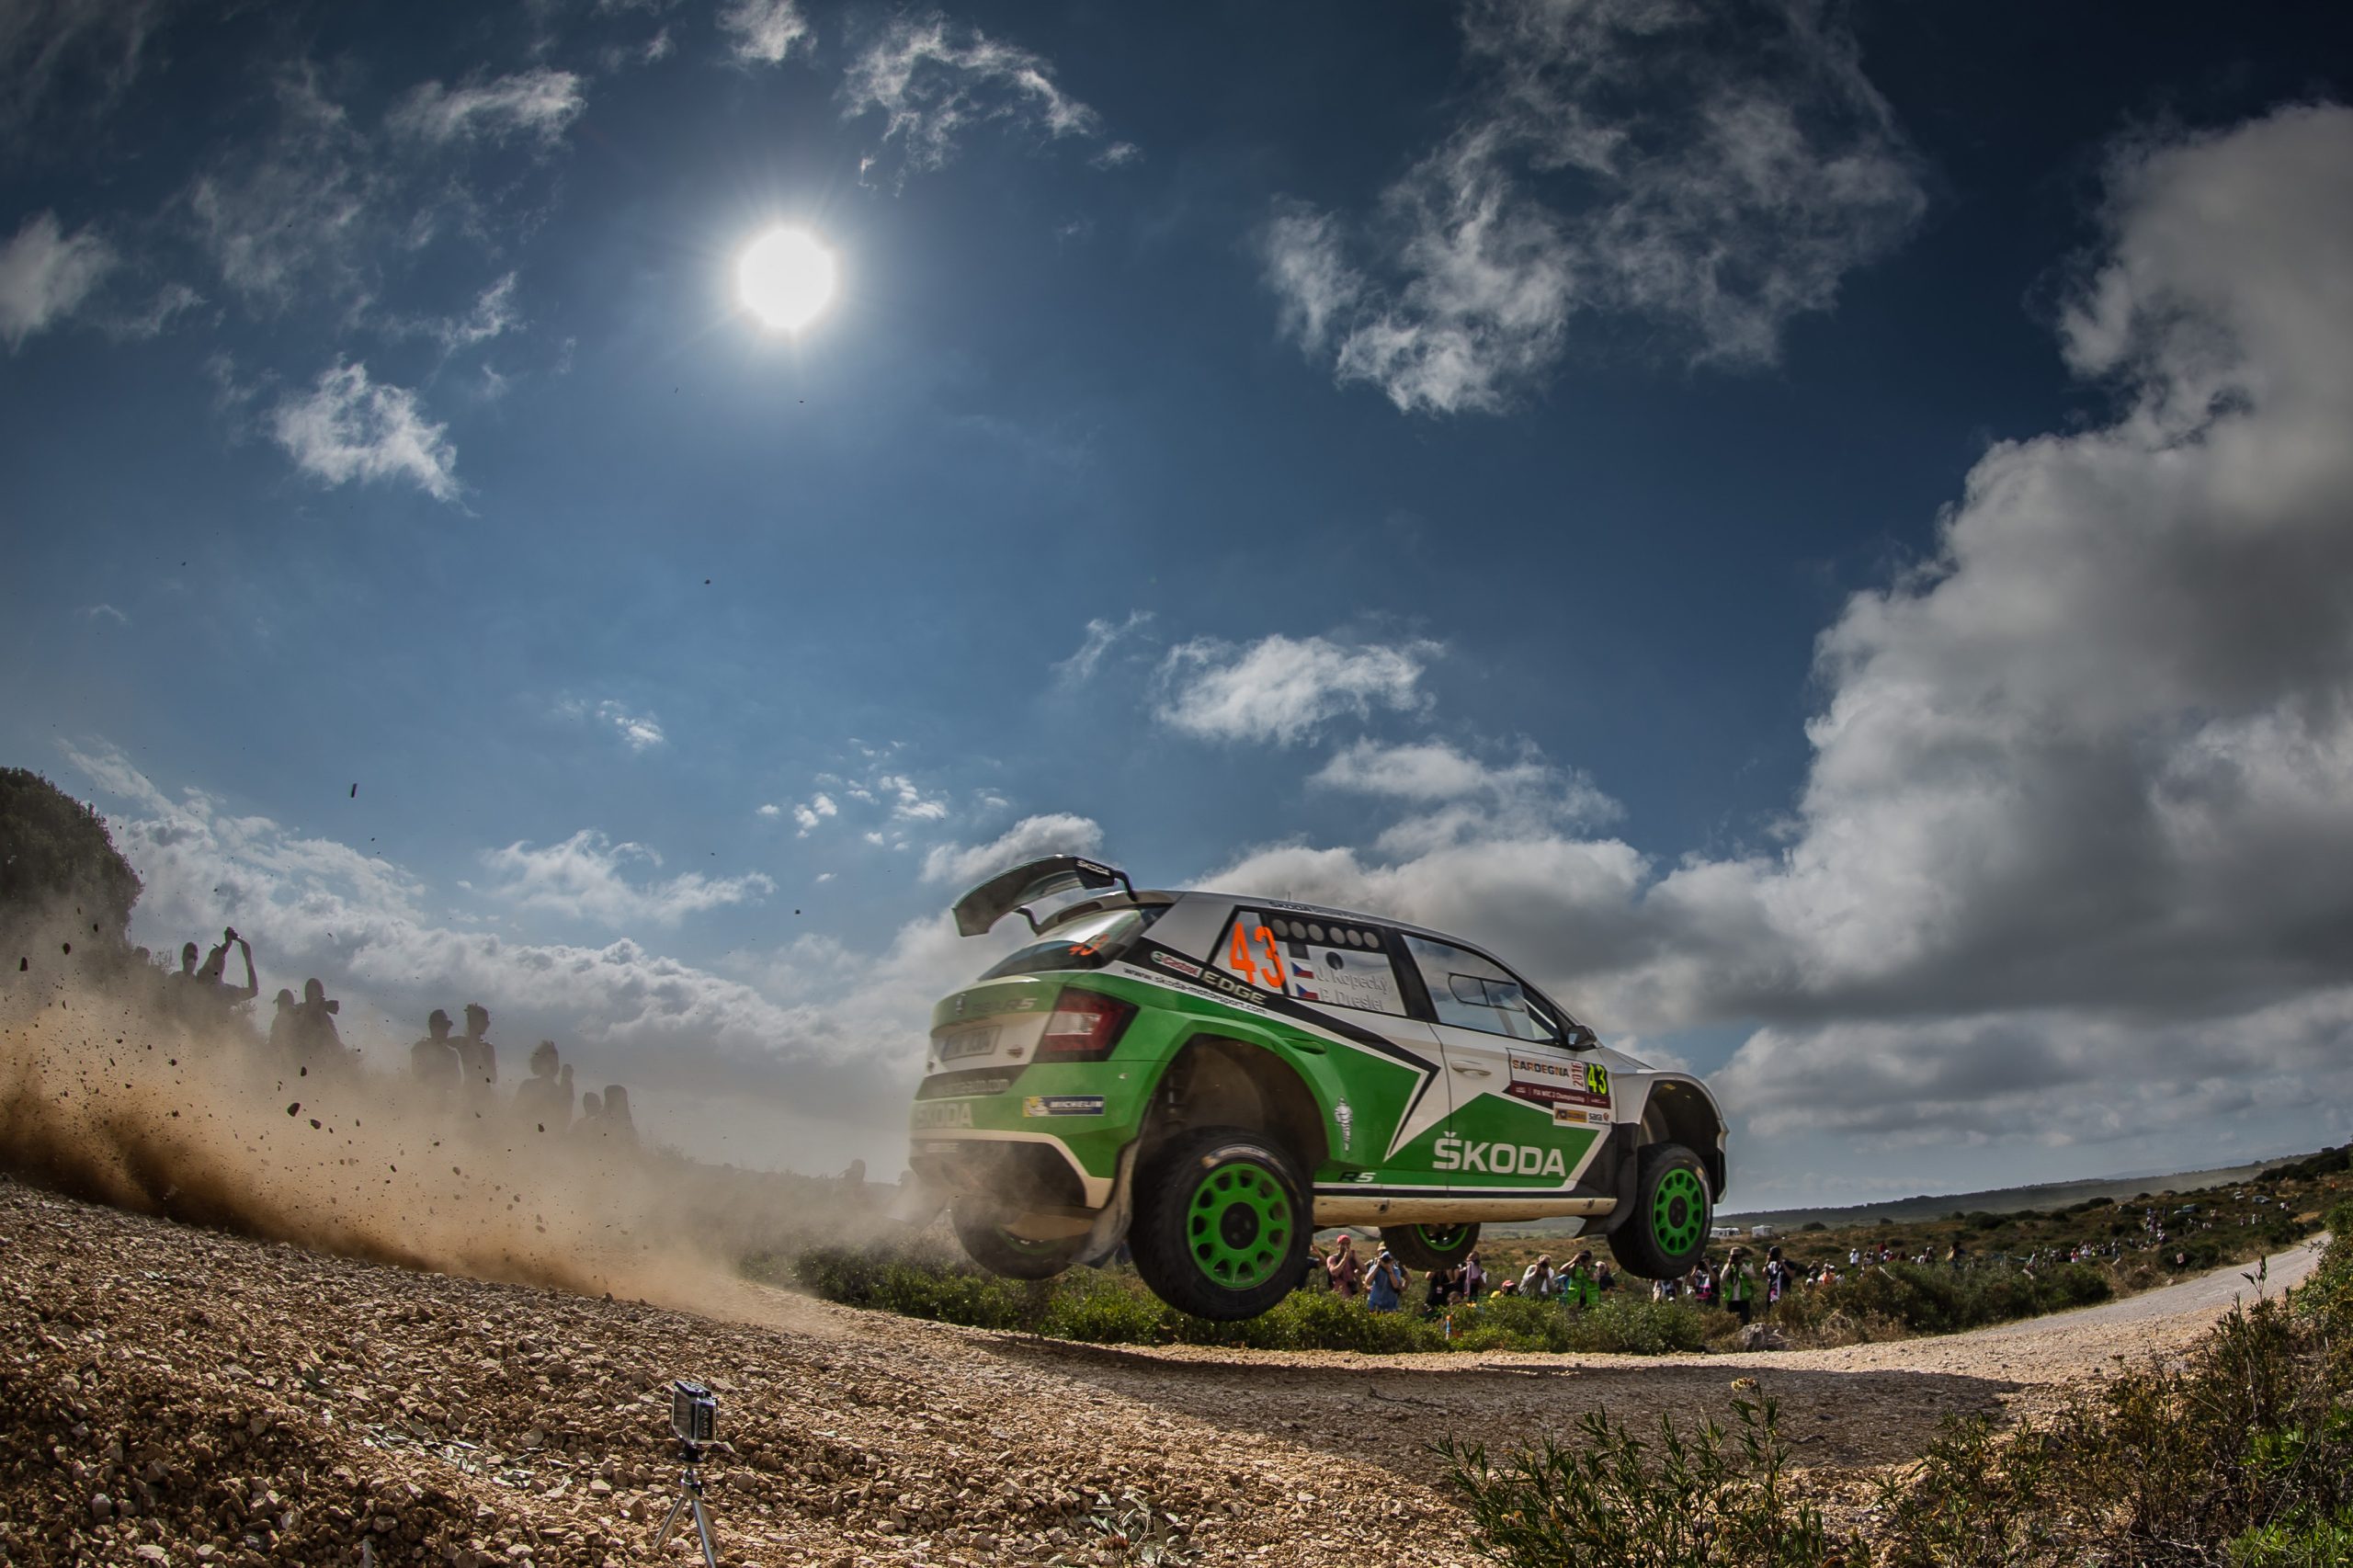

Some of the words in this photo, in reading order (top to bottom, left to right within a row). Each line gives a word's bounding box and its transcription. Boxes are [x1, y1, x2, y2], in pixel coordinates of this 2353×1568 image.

[1228, 921, 1286, 989] 43
[1201, 971, 1267, 1006] EDGE
[1512, 1059, 1571, 1078] SARDEGNA
[1570, 1061, 1585, 1088] 2016
[1586, 1062, 1608, 1096] 43
[1432, 1131, 1566, 1177] ŠKODA
[1337, 1171, 1377, 1183] R5
